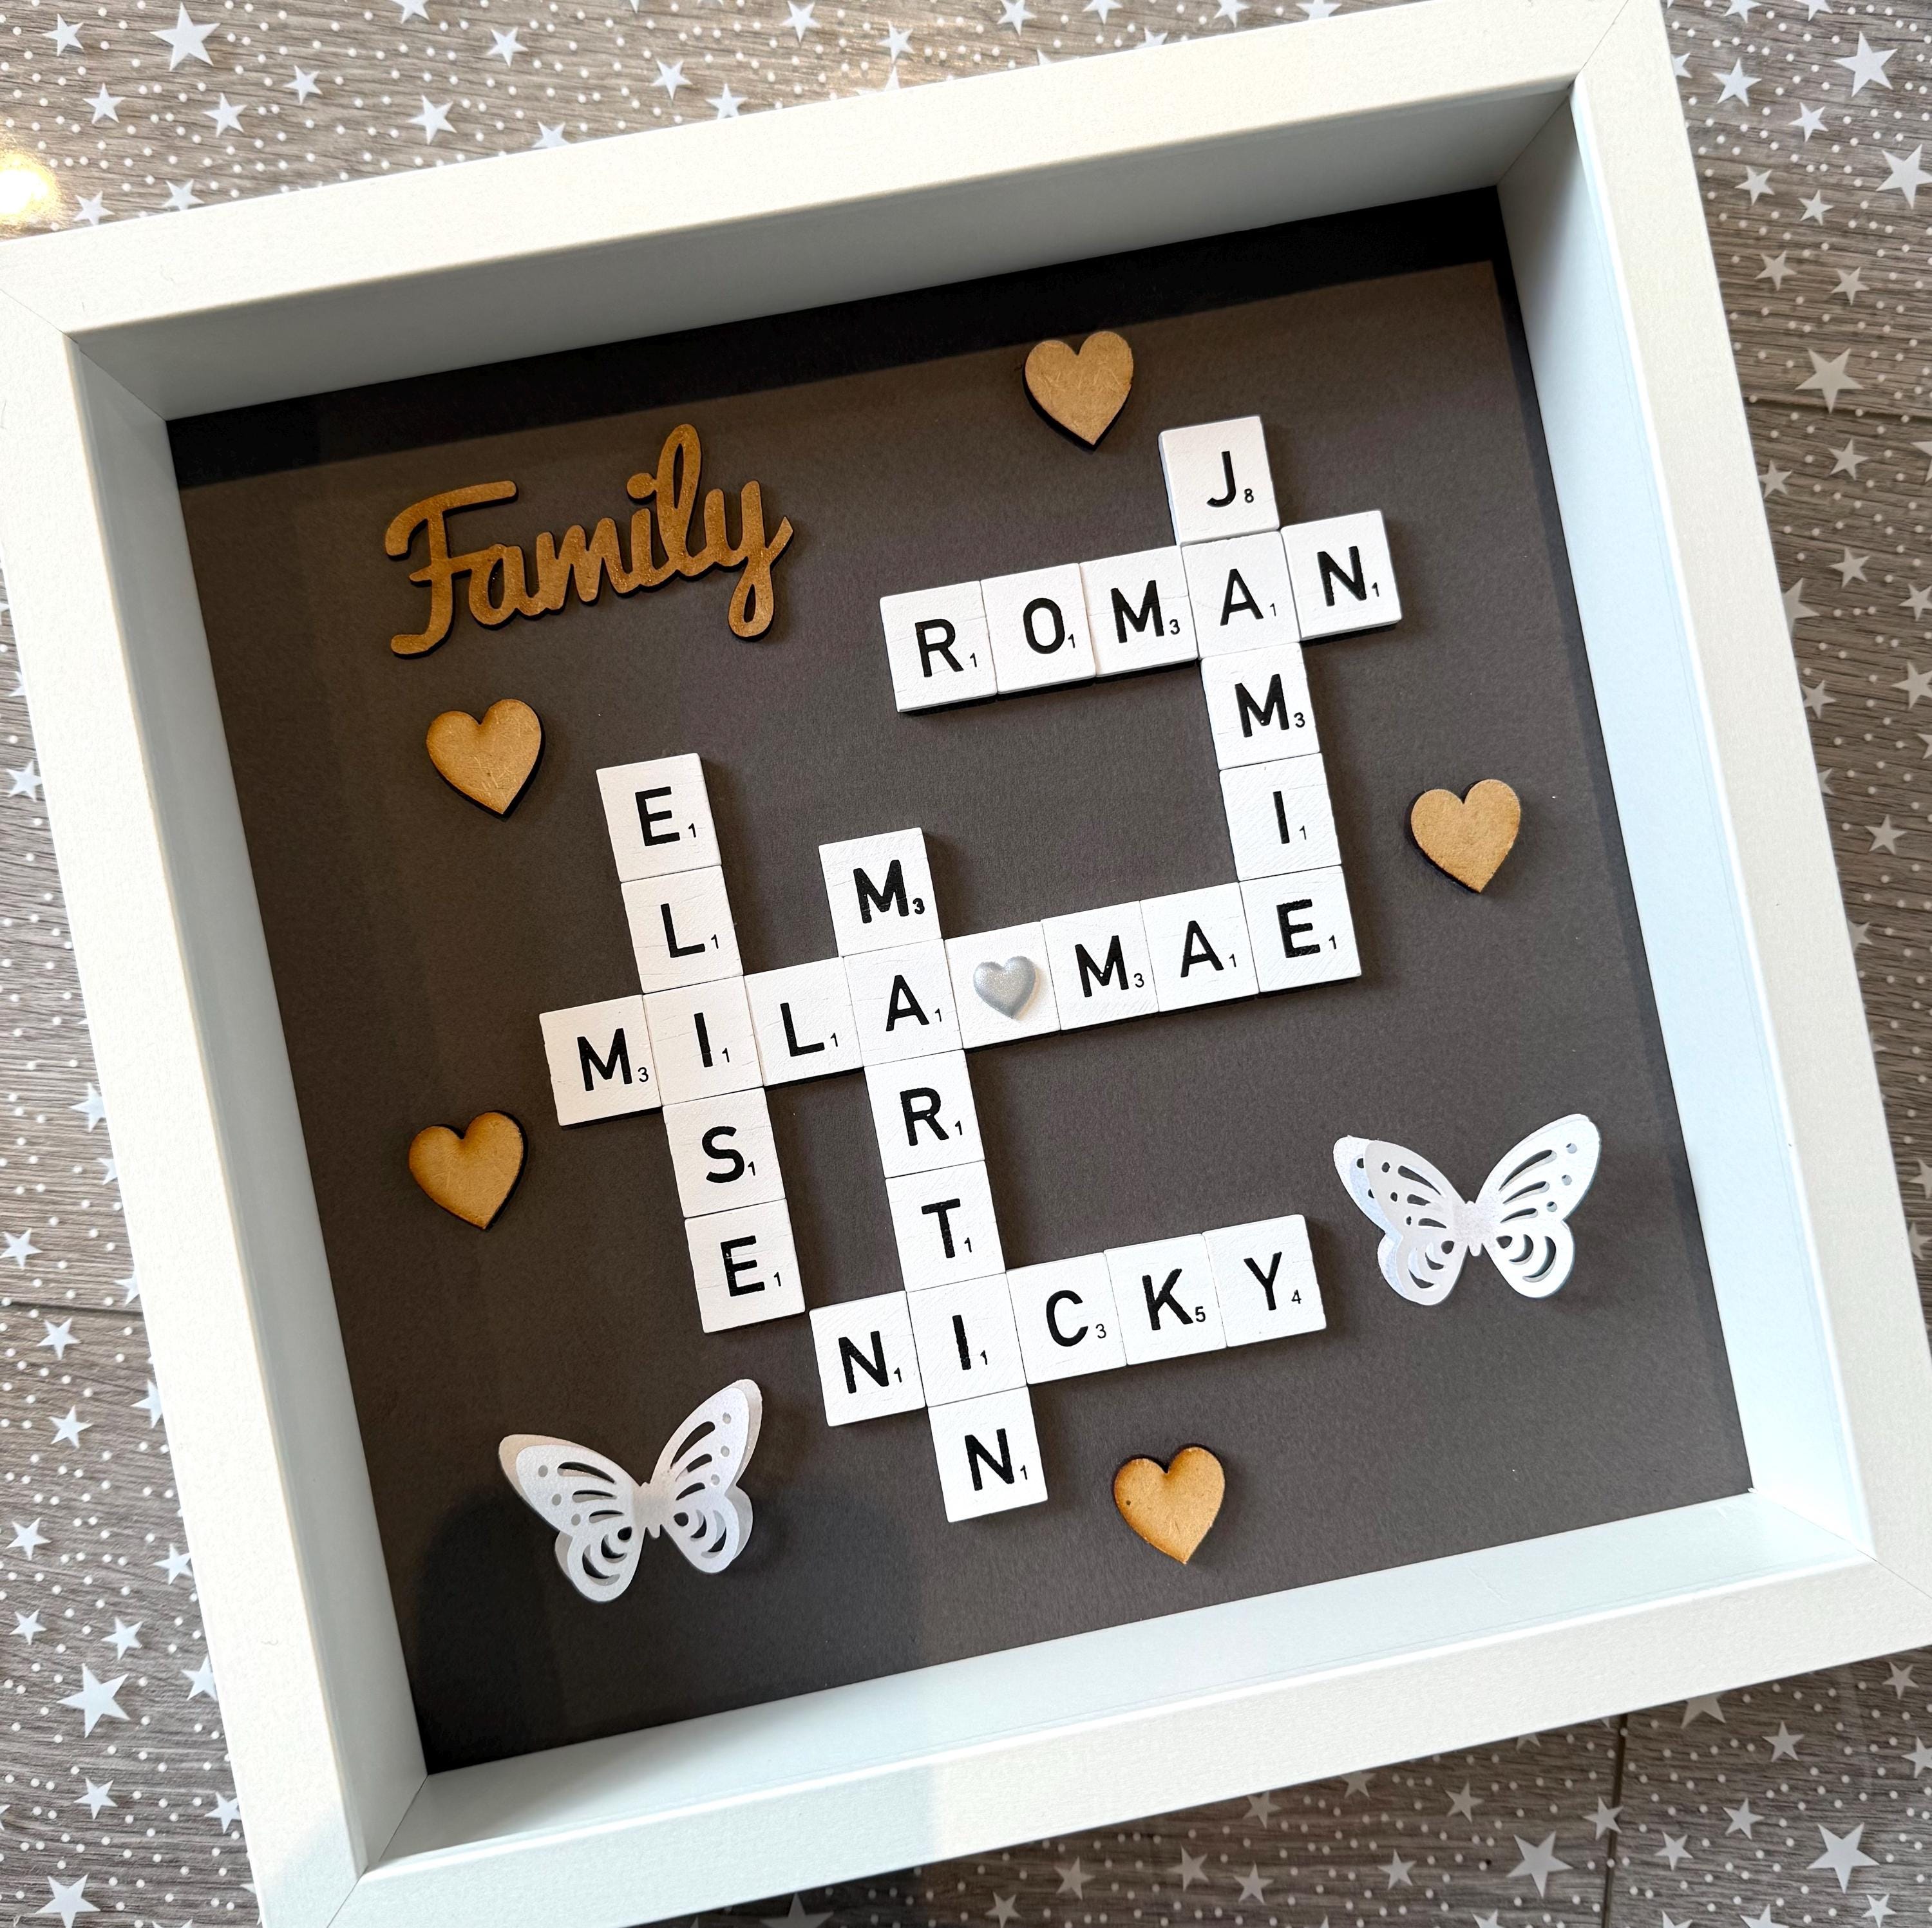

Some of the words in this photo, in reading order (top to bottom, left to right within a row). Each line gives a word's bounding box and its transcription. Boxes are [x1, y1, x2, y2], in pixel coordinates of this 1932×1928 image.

[386, 424, 793, 655] Family
[914, 545, 1367, 678] ROMAN
[838, 1251, 1282, 1394] NICKY
